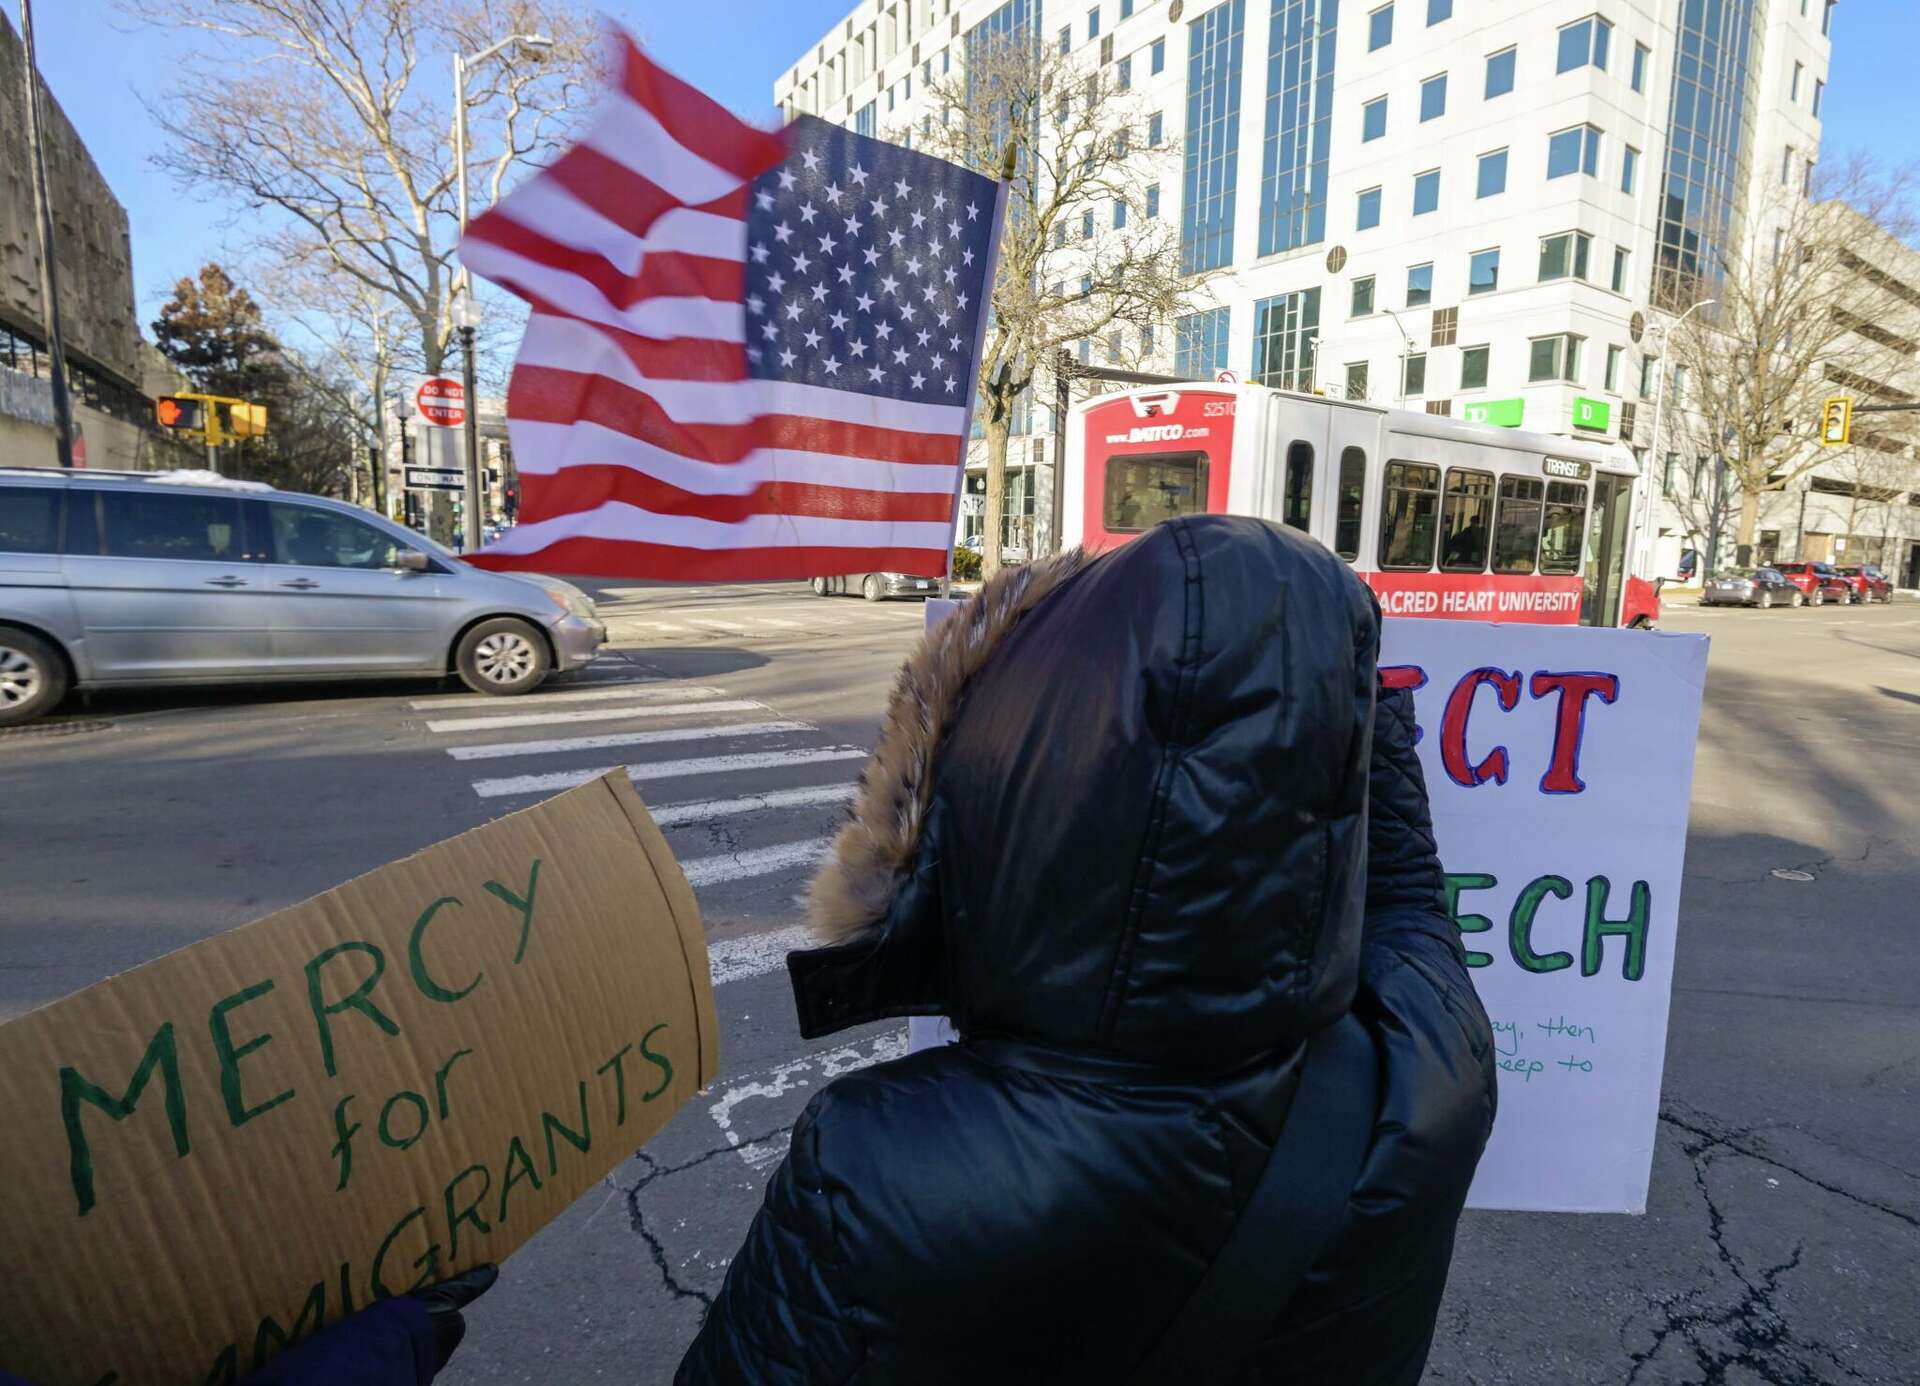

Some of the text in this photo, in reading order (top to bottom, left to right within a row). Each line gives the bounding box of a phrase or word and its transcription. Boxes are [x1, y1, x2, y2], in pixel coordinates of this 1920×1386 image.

[424, 384, 464, 399] DO NOT
[428, 408, 463, 418] ENTER
[1580, 403, 1592, 420] TD
[1545, 458, 1580, 477] TRANSIT
[416, 473, 462, 484] ONE WAY
[1375, 590, 1580, 613] ACRED HEART UNIVERSITY
[59, 858, 542, 1217] MERCY
[1537, 1016, 1595, 1044] then
[1496, 1055, 1593, 1083] eep to
[331, 1048, 474, 1192] for
